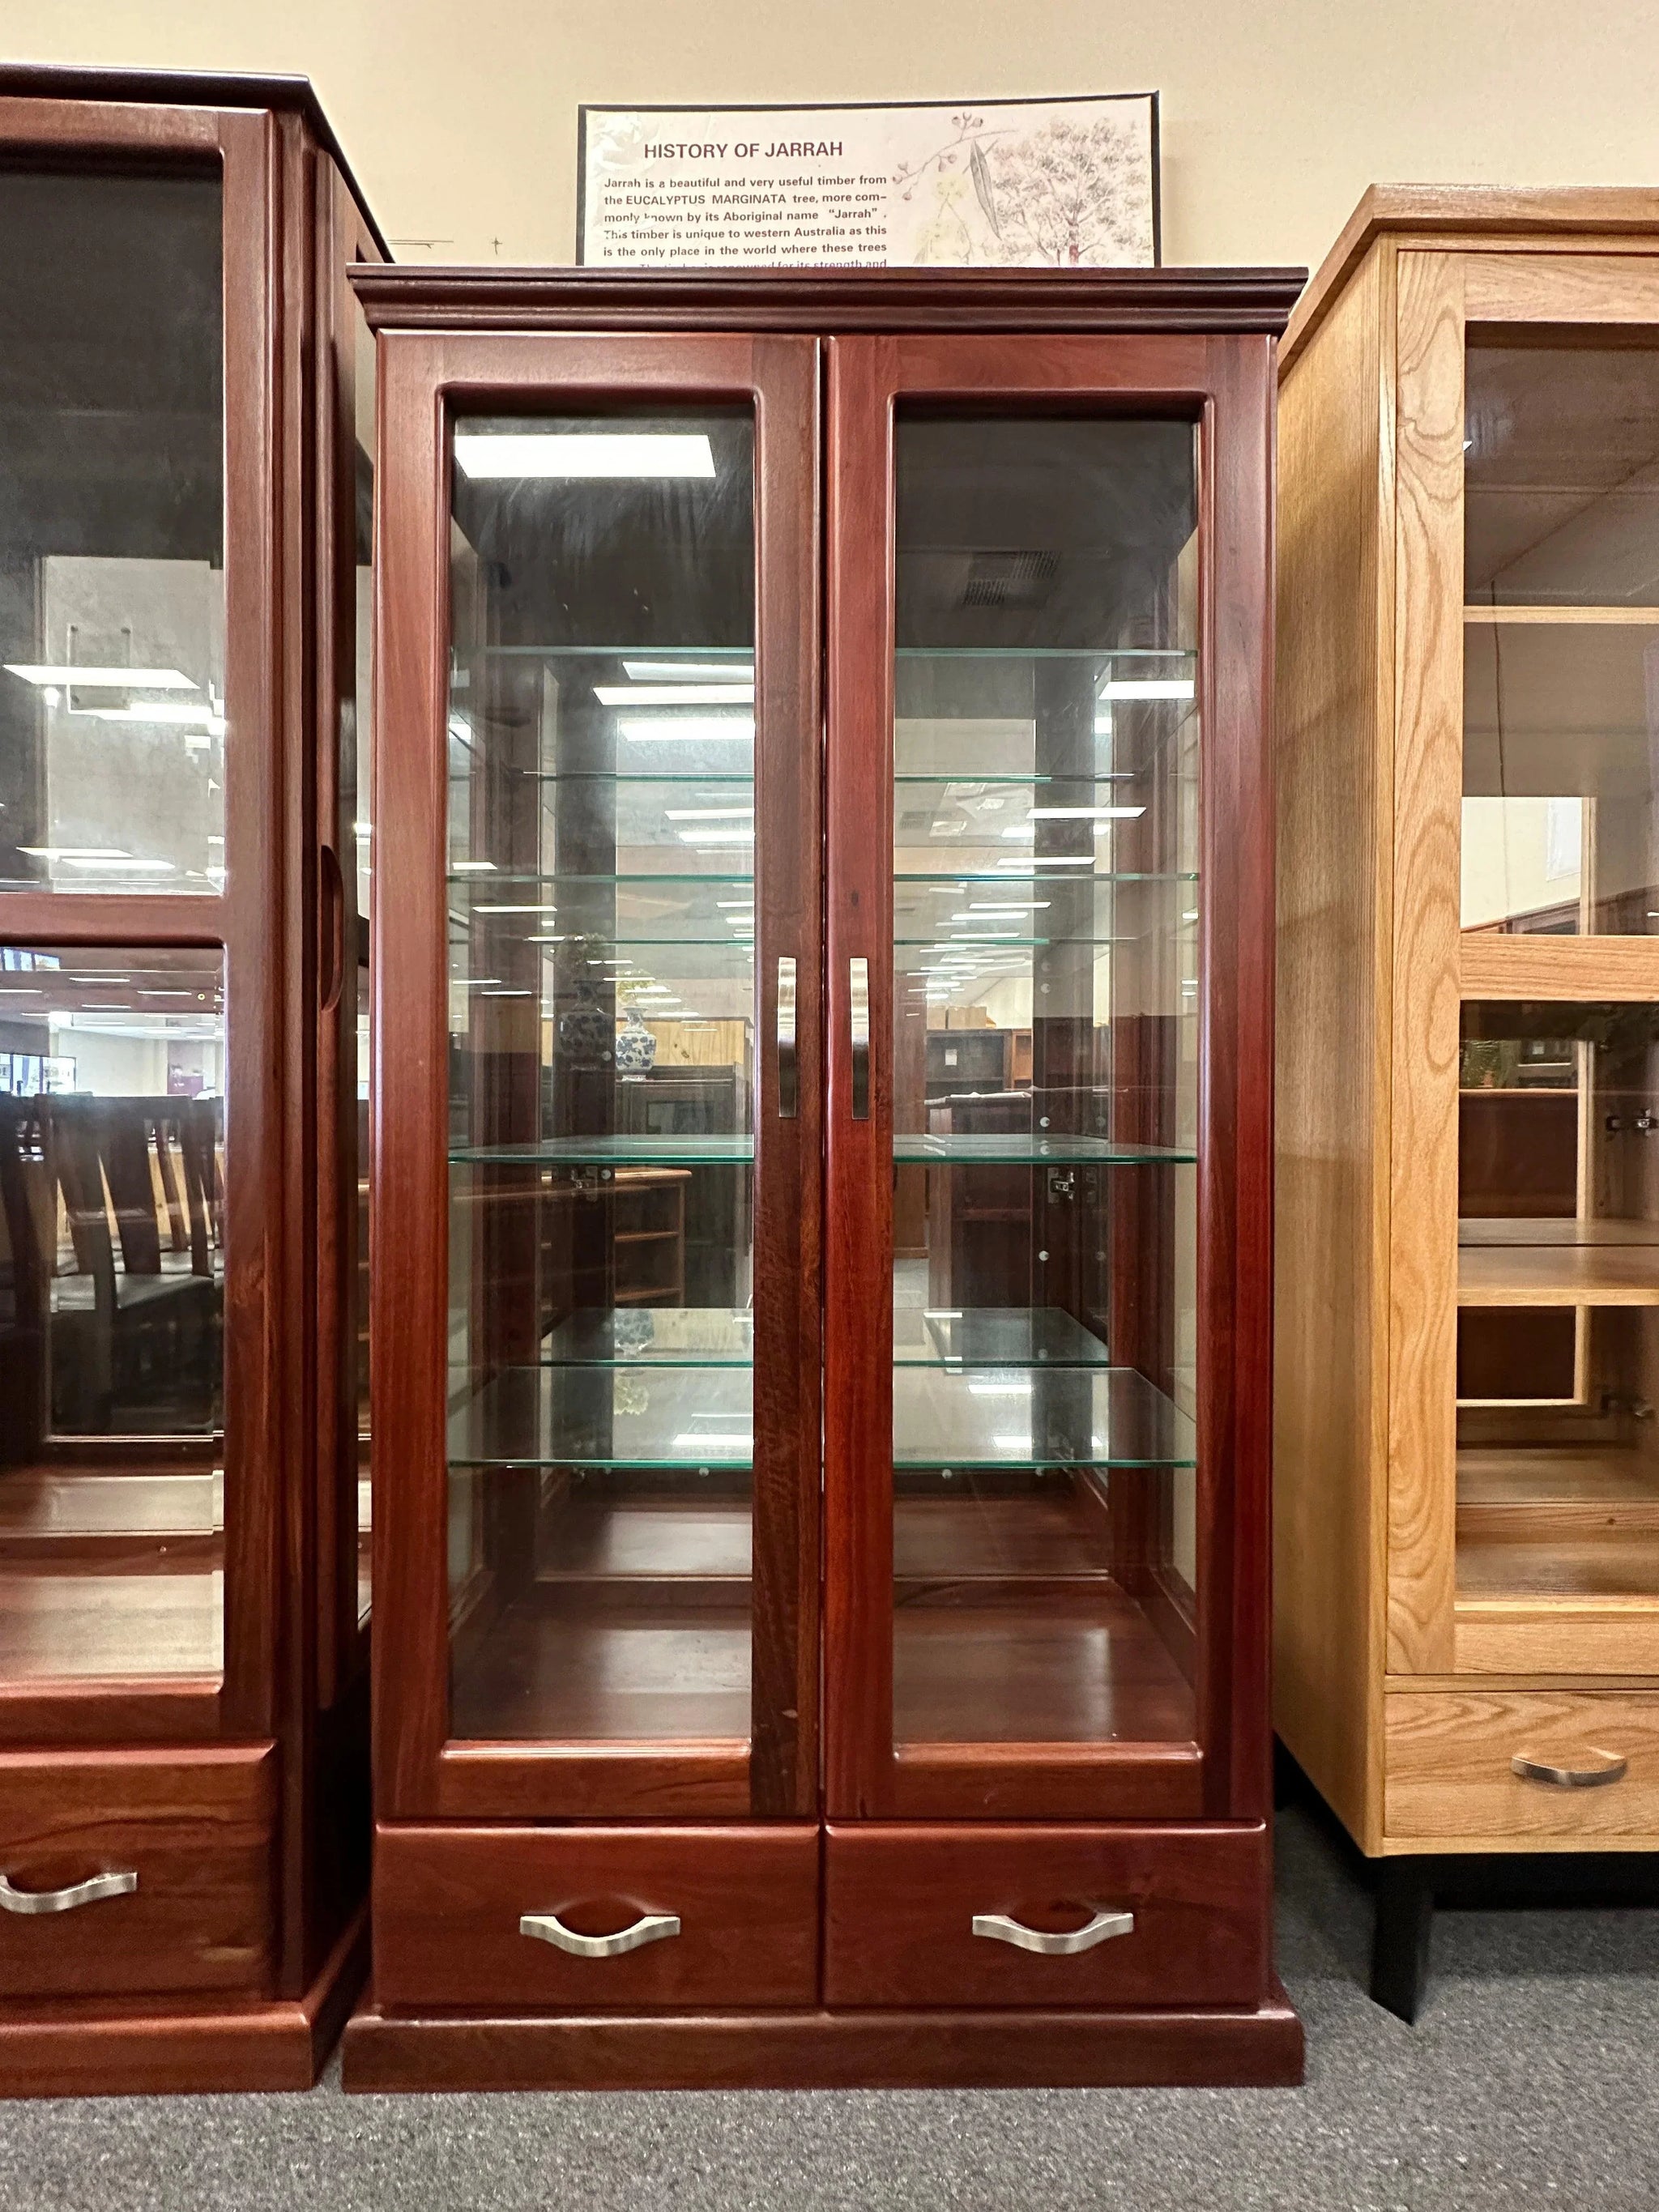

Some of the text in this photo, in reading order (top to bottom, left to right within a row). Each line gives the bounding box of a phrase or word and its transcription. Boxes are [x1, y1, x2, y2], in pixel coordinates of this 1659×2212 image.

[644, 142, 842, 159] HISTORY OF JARRAH
[604, 178, 641, 188] Jarrah
[646, 179, 654, 188] is
[670, 178, 719, 187] beautiful
[724, 177, 745, 187] and
[750, 179, 774, 188] very
[778, 177, 812, 186] useful
[817, 176, 855, 185] timber
[859, 175, 886, 185] from
[604, 196, 623, 205] the
[626, 195, 706, 205] EUCALYPTUS
[712, 194, 787, 204] MARGINATA
[793, 194, 818, 203] tree,
[822, 194, 851, 202] more
[604, 213, 639, 224] monly
[688, 212, 701, 223] by
[706, 212, 719, 221] its
[723, 211, 782, 223] Aboriginal
[787, 212, 818, 220] name
[604, 230, 628, 239] This
[631, 229, 669, 239] timber
[673, 229, 681, 239] is
[686, 229, 724, 240] unique
[728, 230, 740, 238] to
[744, 229, 790, 238] western
[794, 227, 845, 237] Australia
[865, 225, 887, 234] this
[603, 243, 887, 258] is the only place in the world where these trees
[866, 259, 886, 267] and
